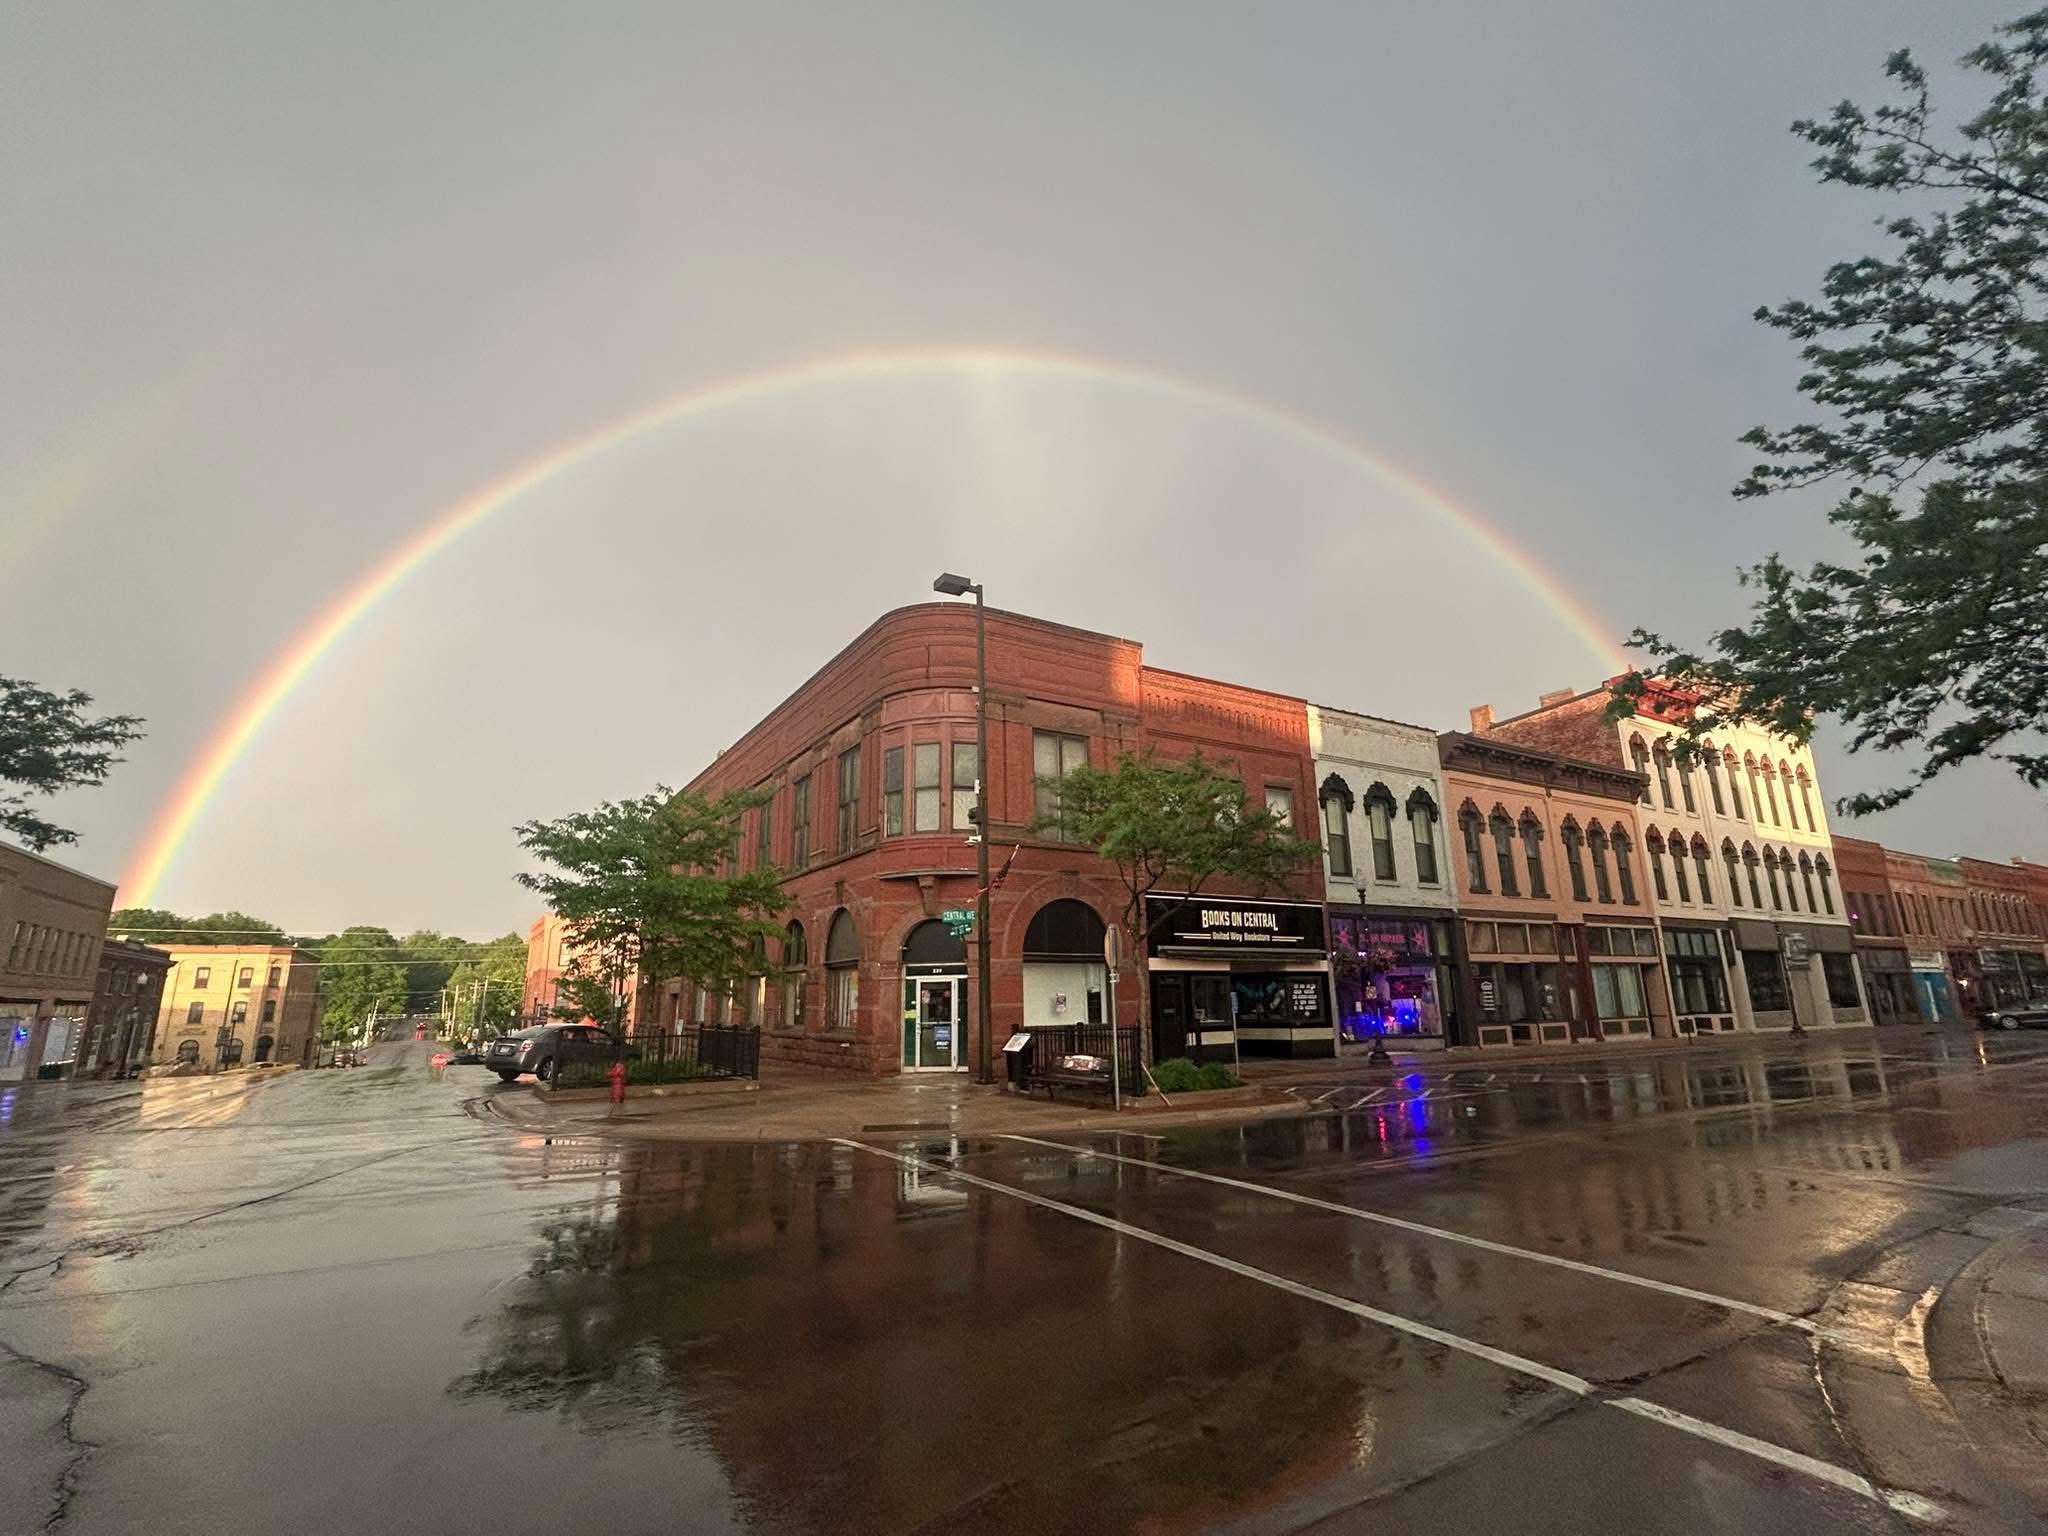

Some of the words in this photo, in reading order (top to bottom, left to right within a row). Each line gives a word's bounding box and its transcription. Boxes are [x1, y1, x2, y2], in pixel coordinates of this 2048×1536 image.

[1201, 909, 1230, 929] BOOKS
[1231, 911, 1243, 927] ON
[1243, 911, 1279, 932] CENTRAL
[1212, 931, 1230, 940] United
[1230, 931, 1243, 942] Way
